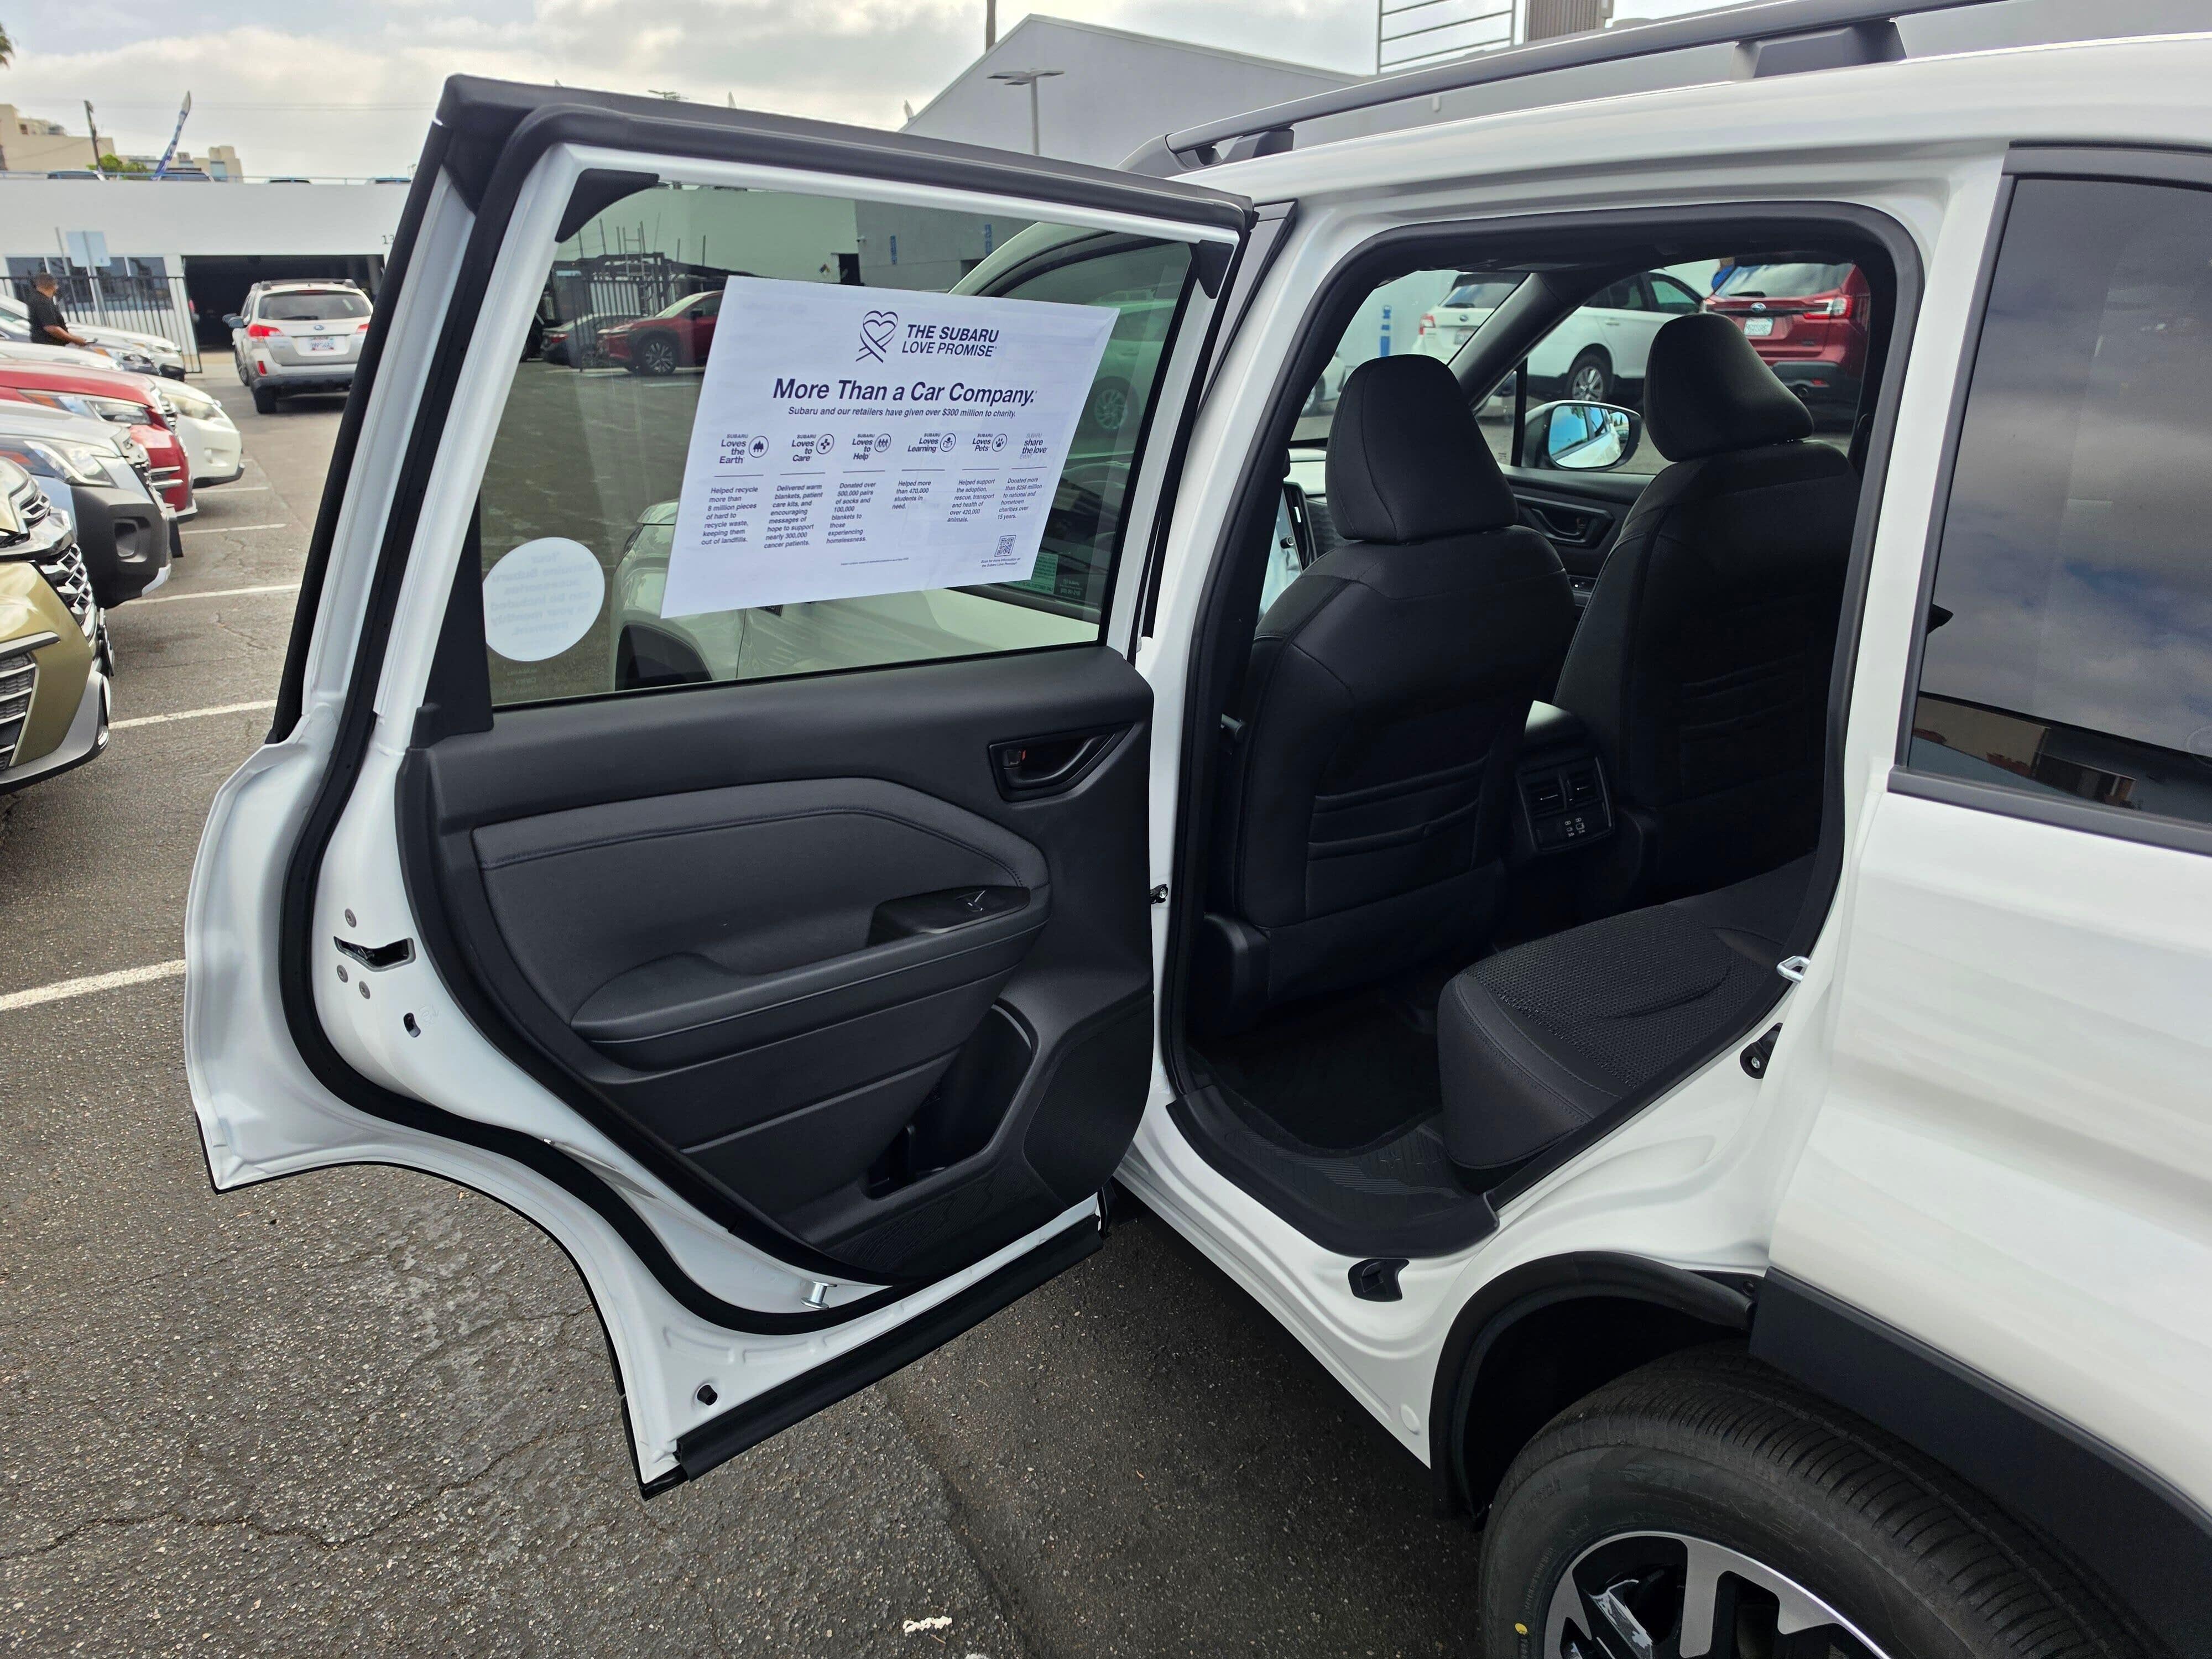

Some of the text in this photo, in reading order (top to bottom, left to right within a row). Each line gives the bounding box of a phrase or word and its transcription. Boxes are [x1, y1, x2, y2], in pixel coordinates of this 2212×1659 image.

[907, 324, 999, 342] THE SUBARU
[902, 341, 994, 357] LOVE PROMISE
[773, 378, 1034, 406] More Than a Car Company.
[788, 406, 818, 415] Subaru
[852, 408, 883, 416] retailers
[904, 408, 924, 418] given
[942, 409, 959, 417] $300
[993, 410, 1016, 418] charity.
